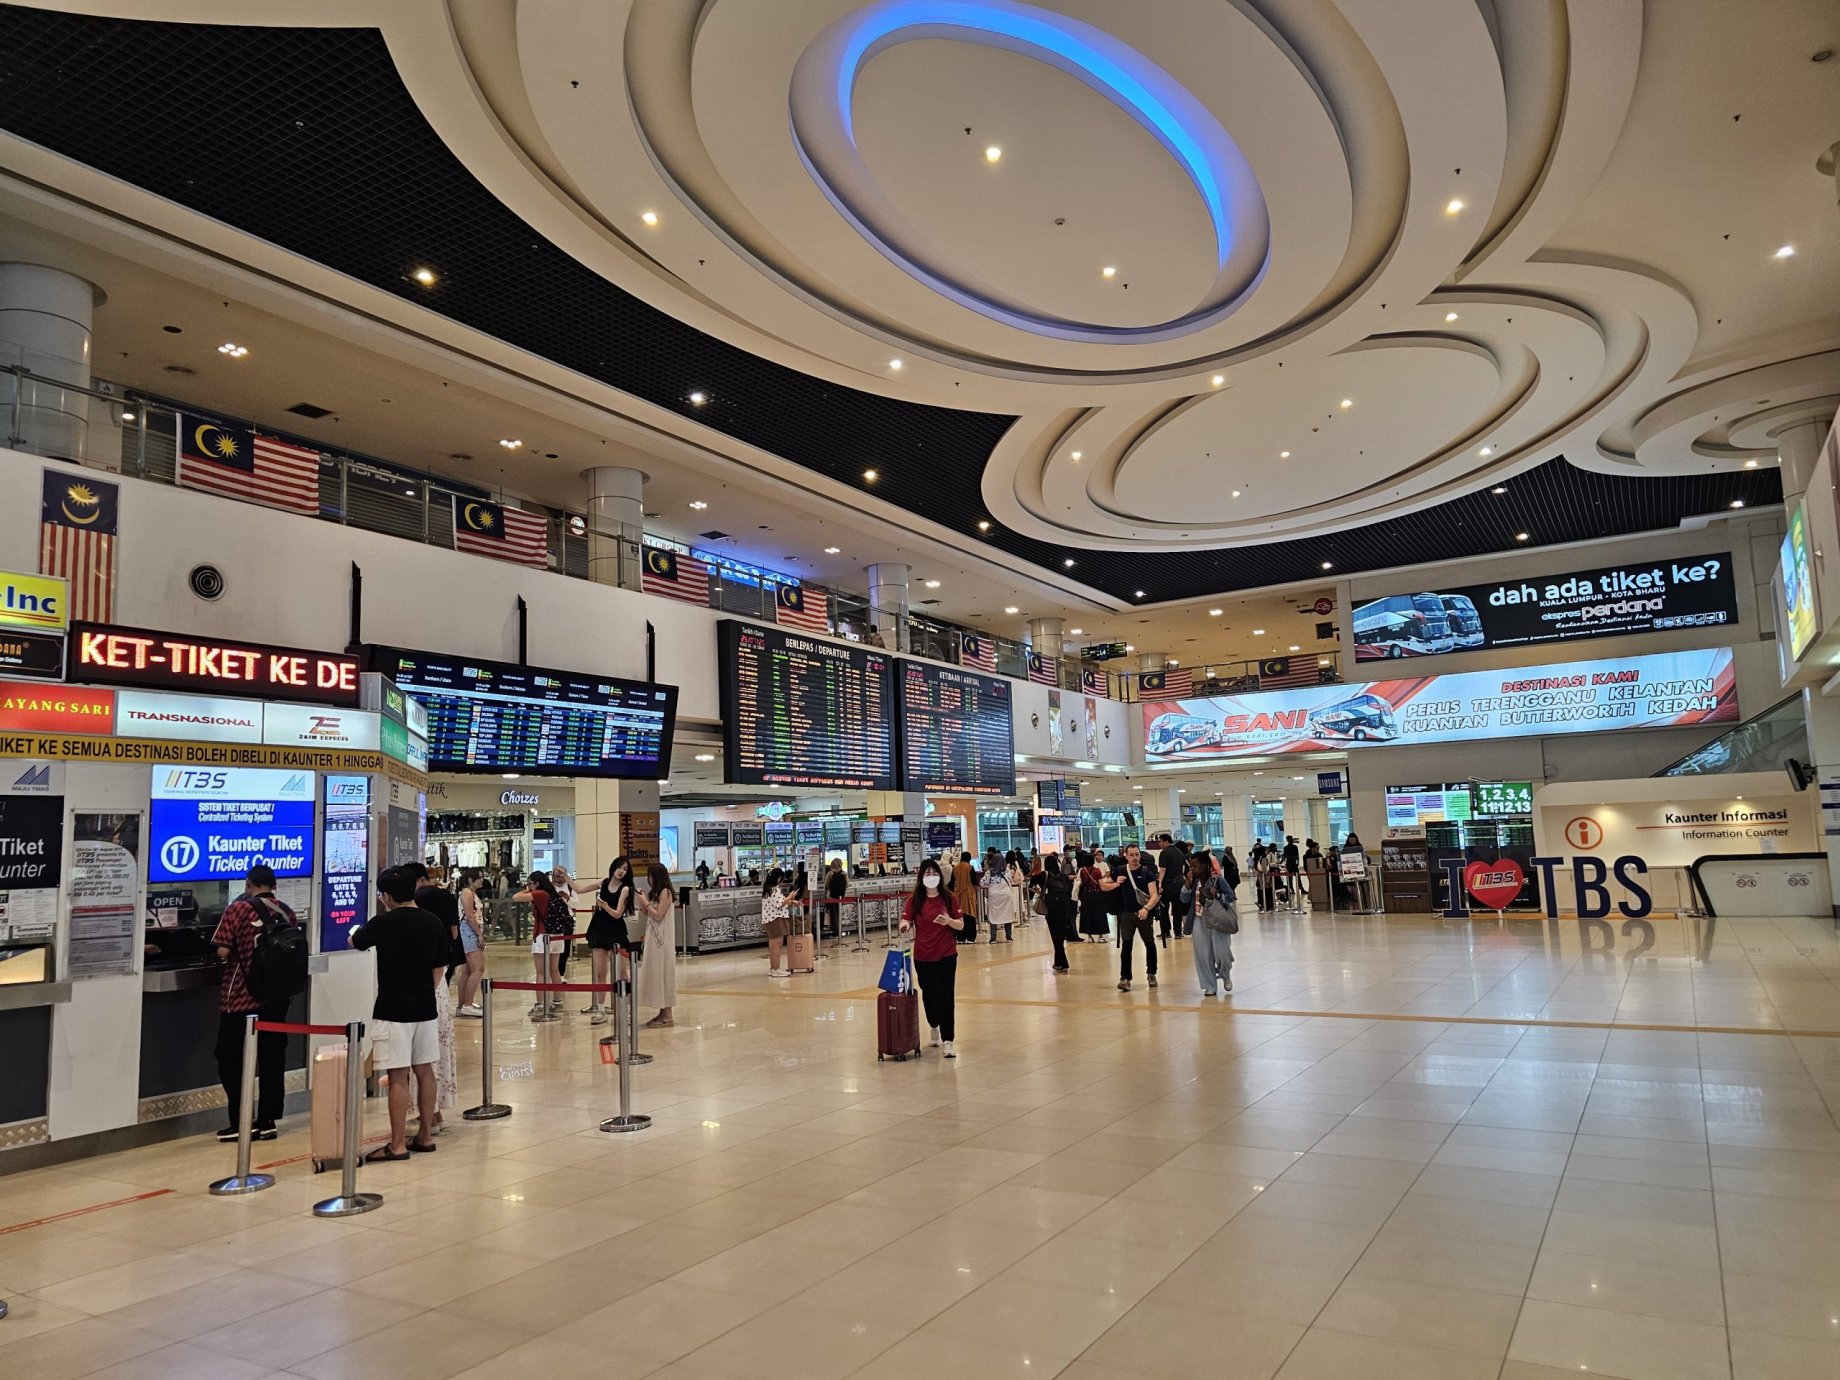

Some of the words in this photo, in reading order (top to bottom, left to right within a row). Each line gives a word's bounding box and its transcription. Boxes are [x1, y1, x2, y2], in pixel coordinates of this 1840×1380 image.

[1489, 584, 1538, 606] dah
[1545, 577, 1593, 599] ada
[1600, 568, 1665, 593] tiket
[1672, 560, 1721, 584] ke?
[1539, 598, 1567, 607] KUALA
[1568, 594, 1603, 604] LUMPUR
[1611, 591, 1634, 599] KOTA
[1636, 586, 1666, 596] BHARU
[1541, 610, 1581, 621] ekspres
[1581, 598, 1664, 621] perdana
[785, 637, 814, 653] BERLEPAS
[818, 646, 850, 660] DEPARTURE
[81, 632, 262, 680] KET-TIKET
[270, 654, 308, 686] KE
[316, 660, 356, 690] DE
[939, 671, 960, 683] KETIBAAN
[963, 676, 980, 687] ARRIVAL
[1502, 675, 1586, 693] DESTINASI
[1592, 670, 1639, 684] KAMI
[0, 696, 66, 712] AYANG
[71, 702, 110, 716] SARI
[1406, 700, 1461, 717] PERLIS
[1472, 689, 1596, 712] TERENGGANU
[1609, 678, 1714, 701] KELANTAN
[127, 711, 255, 727] TRANSNASIONAL
[1223, 709, 1308, 734] SANI
[1403, 714, 1488, 733] KUANTAN
[1500, 702, 1634, 726] BUTTERWORTH
[1648, 696, 1718, 714] KEDAH
[38, 739, 58, 755] KE
[62, 740, 111, 757] SEMUA
[115, 743, 183, 760] DESTINASI
[186, 747, 227, 762] BOLEH
[231, 749, 266, 764] DIBELI
[270, 751, 280, 765] DI
[283, 752, 332, 767] KAUNTER
[336, 754, 340, 767] 1
[344, 755, 379, 769] HINGGA
[184, 771, 228, 789] TBS
[341, 784, 364, 794] TBS
[1318, 778, 1340, 789] SAMSUNG
[501, 790, 539, 804] Choizes
[1480, 789, 1491, 801] 1,
[1492, 789, 1504, 800] 2,
[1506, 788, 1518, 800] 3,
[1519, 787, 1531, 800] 4,
[198, 802, 222, 812] SISTEM
[223, 802, 240, 812] TIKET
[240, 803, 271, 812] BERPUSAT
[1665, 813, 1718, 823] Kaunter
[1721, 809, 1787, 822] Informasi
[198, 812, 230, 822] Centralized
[230, 813, 253, 823] Ticketing
[253, 813, 273, 824] System
[1682, 829, 1743, 840] Information
[1746, 828, 1790, 838] Counter
[0, 838, 45, 855] Tiket
[208, 835, 266, 853] Kaunter
[269, 834, 303, 851] Tiket
[170, 843, 192, 866] 17
[208, 855, 250, 872] Ticket
[252, 854, 304, 871] Counter
[0, 861, 46, 878] unter
[1484, 871, 1515, 885] TBS
[328, 875, 362, 884] DEPARTURE
[1529, 855, 1652, 919] TBS
[153, 896, 183, 907] OPEN
